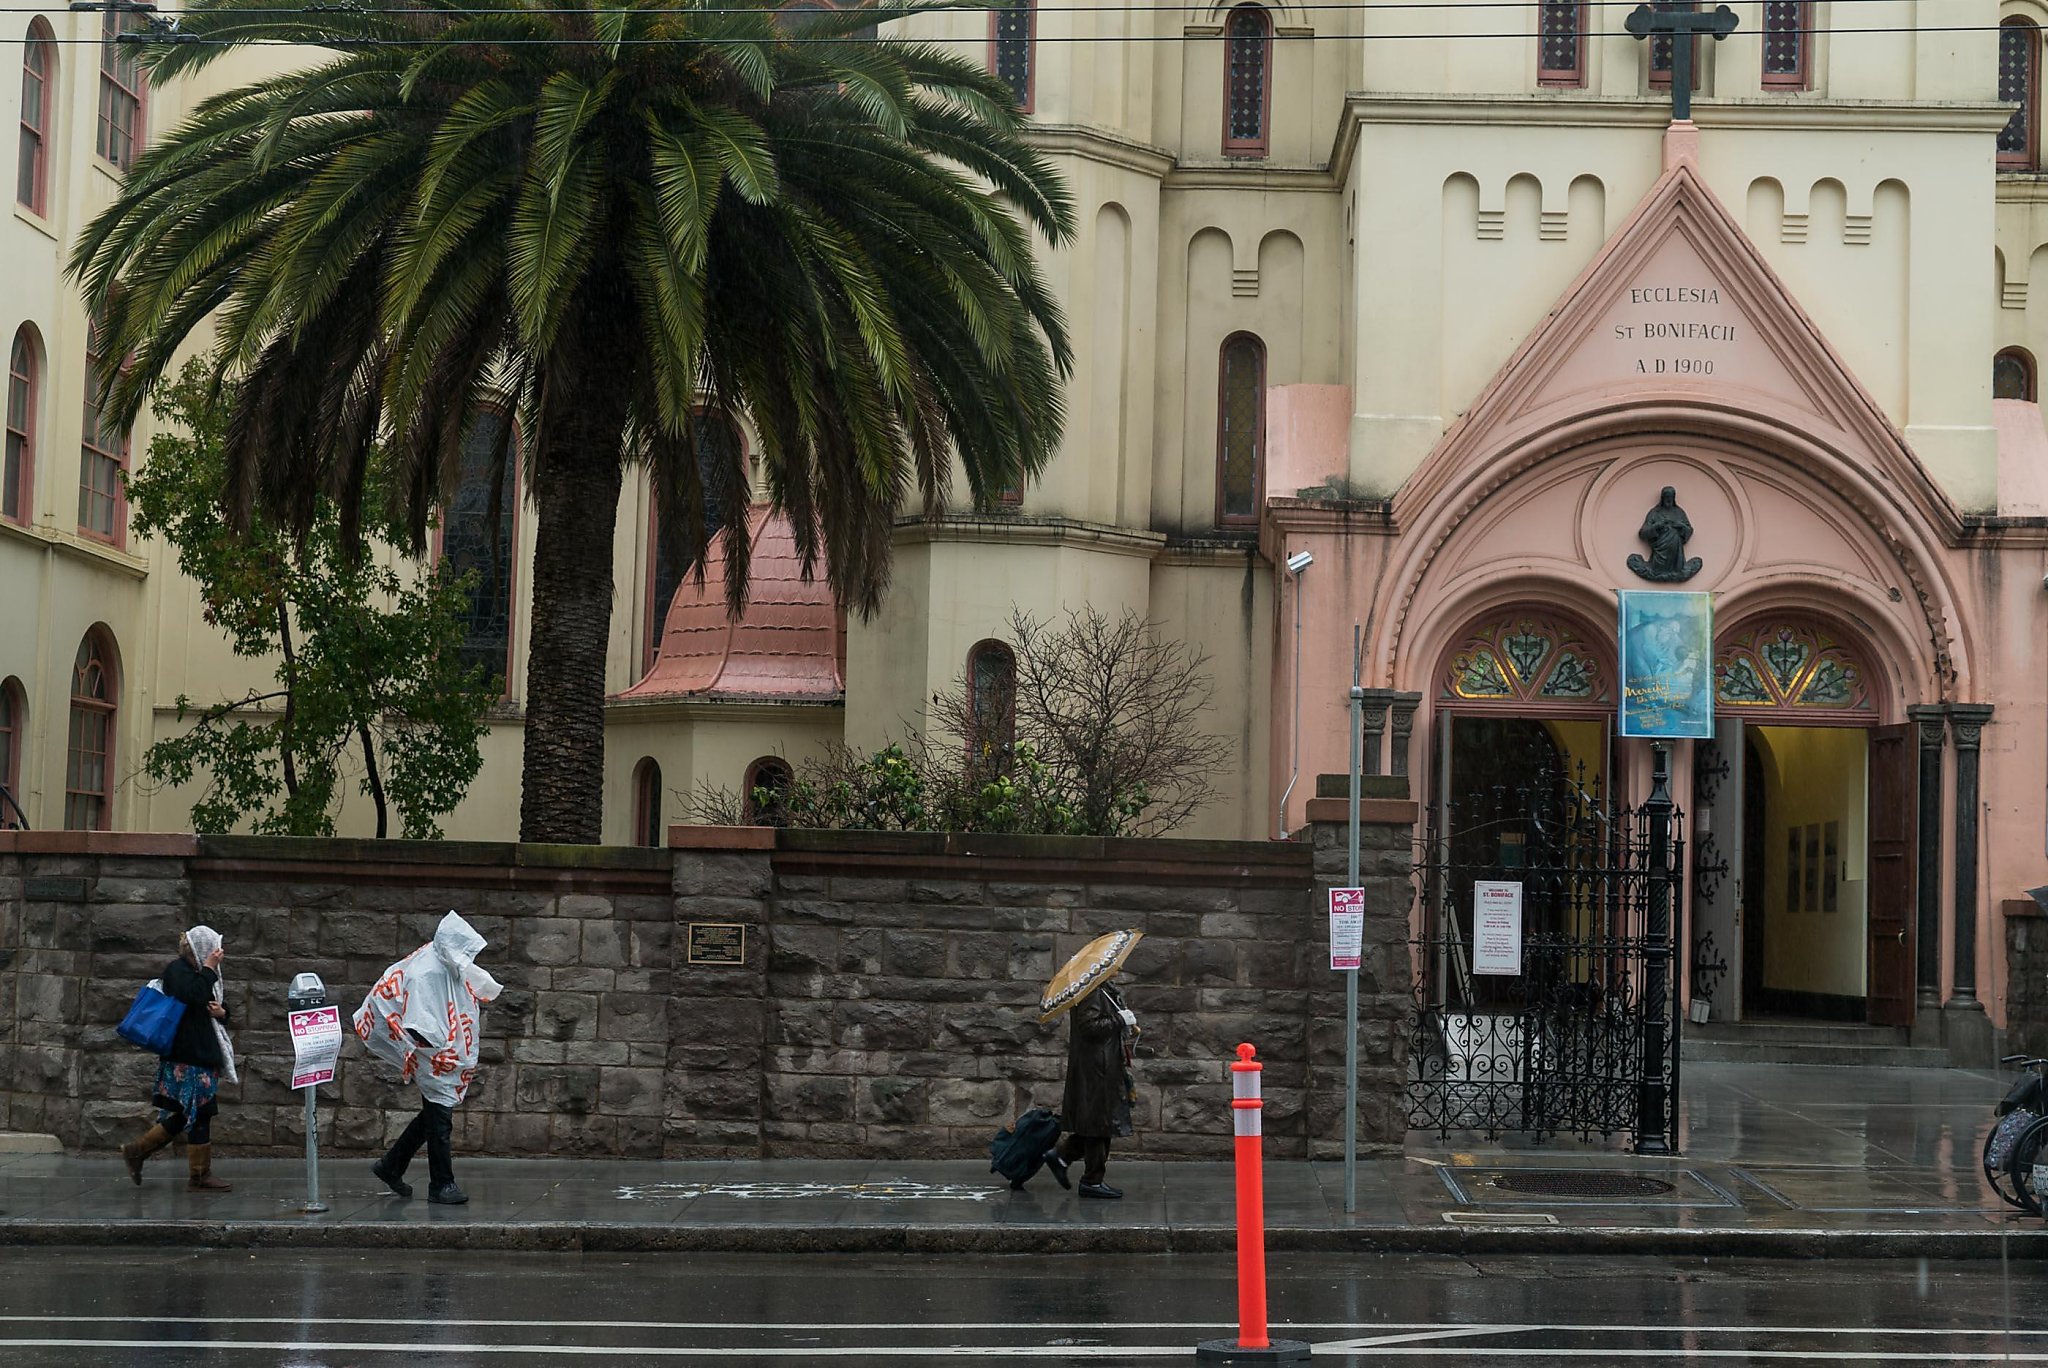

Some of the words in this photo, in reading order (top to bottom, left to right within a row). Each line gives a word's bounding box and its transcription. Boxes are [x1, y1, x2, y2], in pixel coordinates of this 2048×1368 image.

[1631, 288, 1719, 304] ECCLESIA
[1675, 358, 1714, 374] 1900
[1624, 679, 1670, 698] Merciful
[307, 1023, 337, 1033] STOPPING
